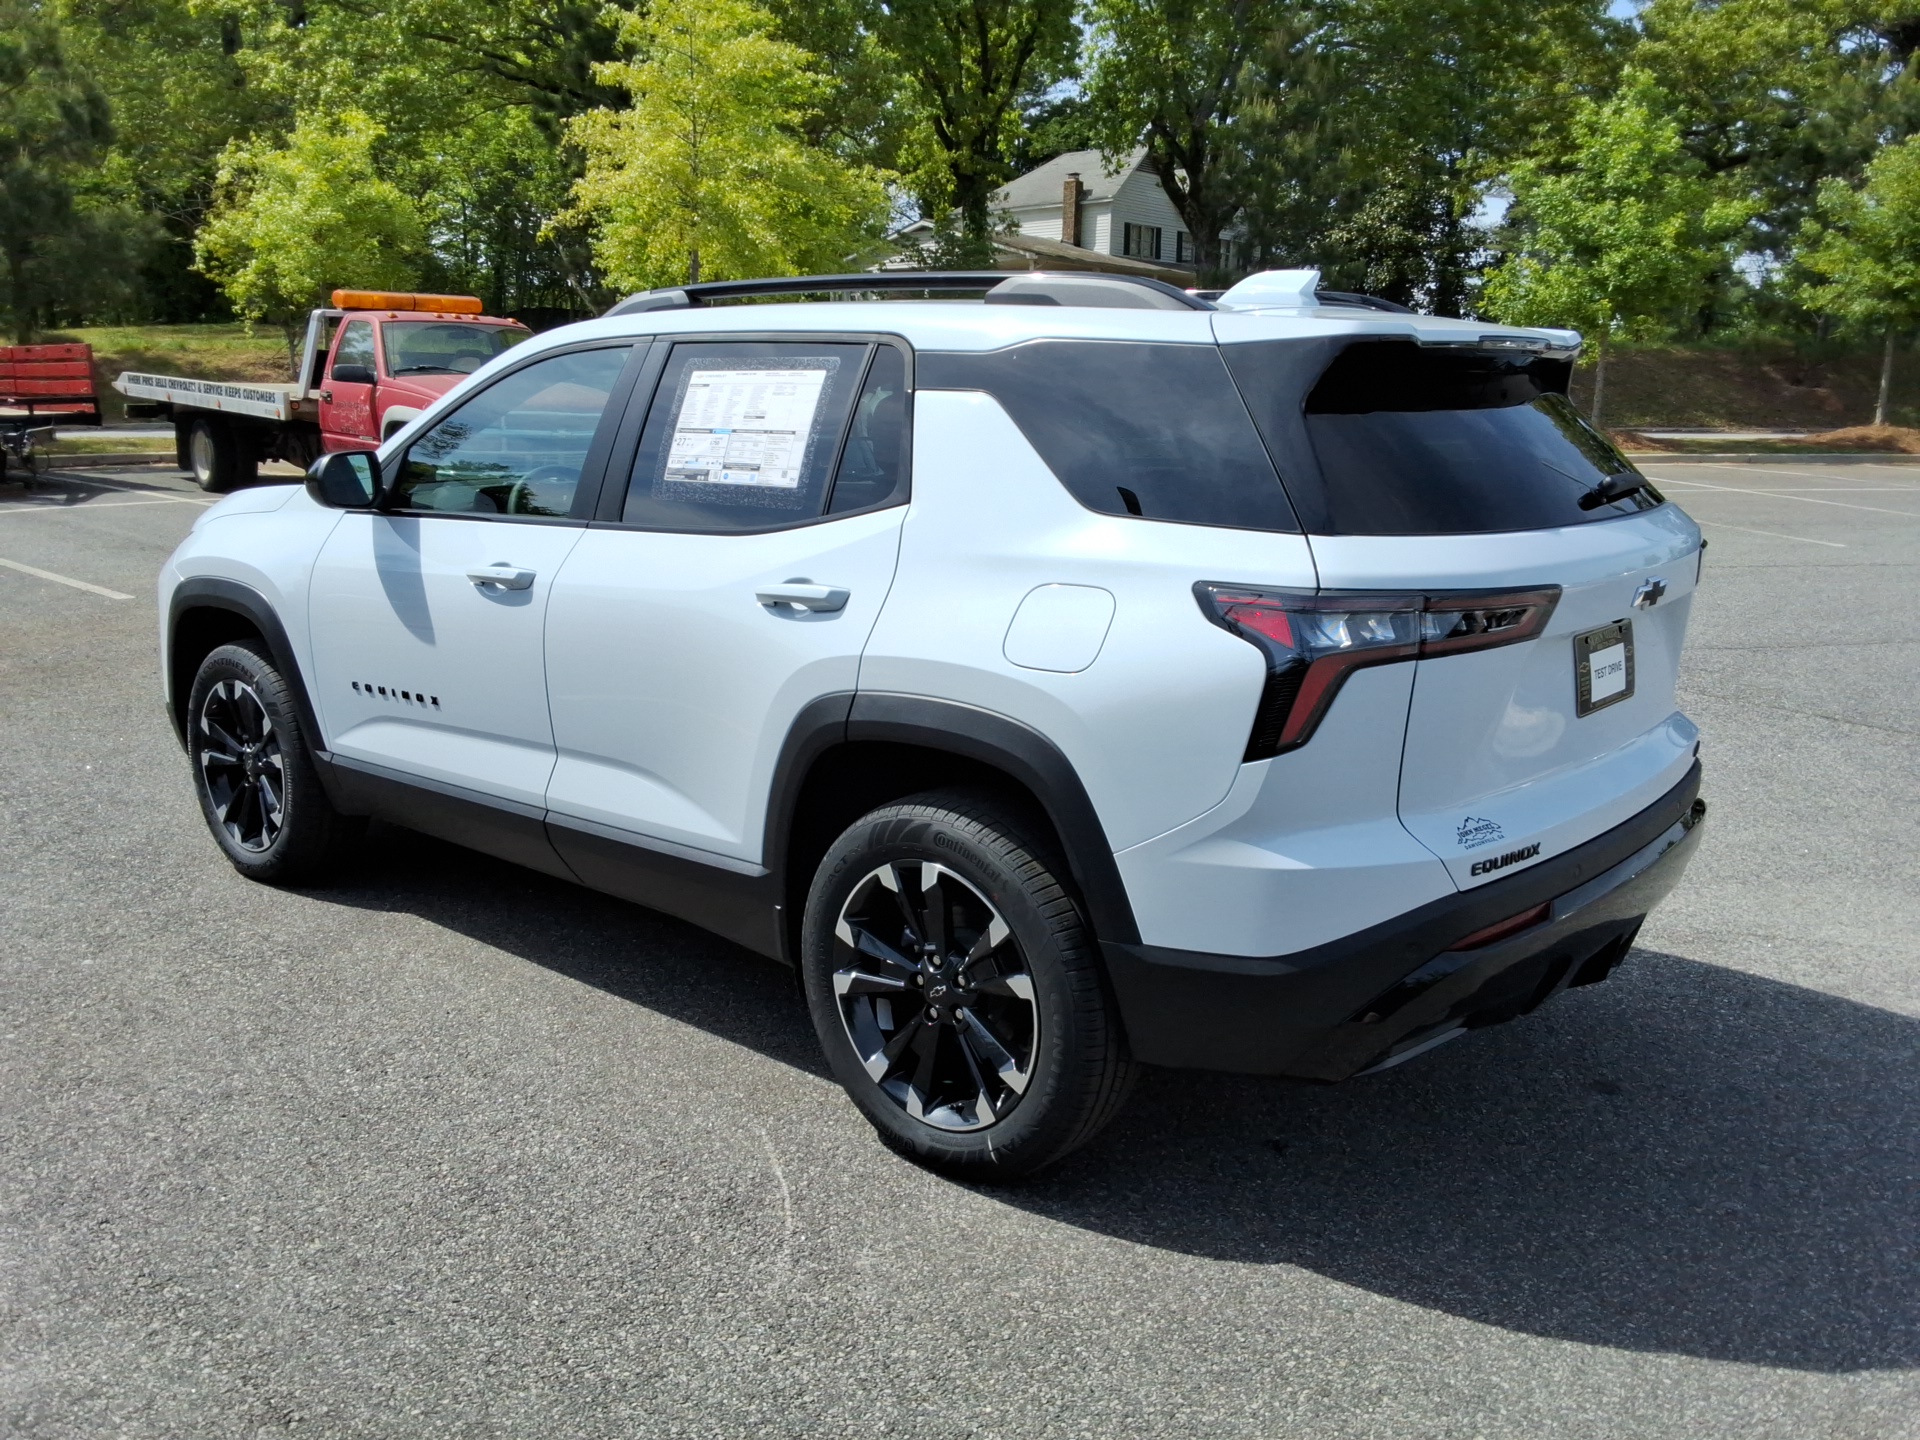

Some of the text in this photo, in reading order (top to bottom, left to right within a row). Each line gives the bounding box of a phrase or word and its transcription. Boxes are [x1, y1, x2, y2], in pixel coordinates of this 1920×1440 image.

[155, 377, 167, 388] SELLS
[168, 379, 196, 392] CHEVROLETS
[203, 383, 223, 396] SERVICE
[225, 385, 241, 399] KEEPS
[243, 388, 276, 403] CUSTOMERS
[1594, 666, 1607, 680] TEST
[1608, 660, 1622, 675] DRIVE
[352, 681, 439, 706] EQUINOX
[1457, 823, 1495, 843] JOHN MEGEL
[933, 831, 1001, 882] Continental
[1471, 842, 1541, 876] EQUINOX
